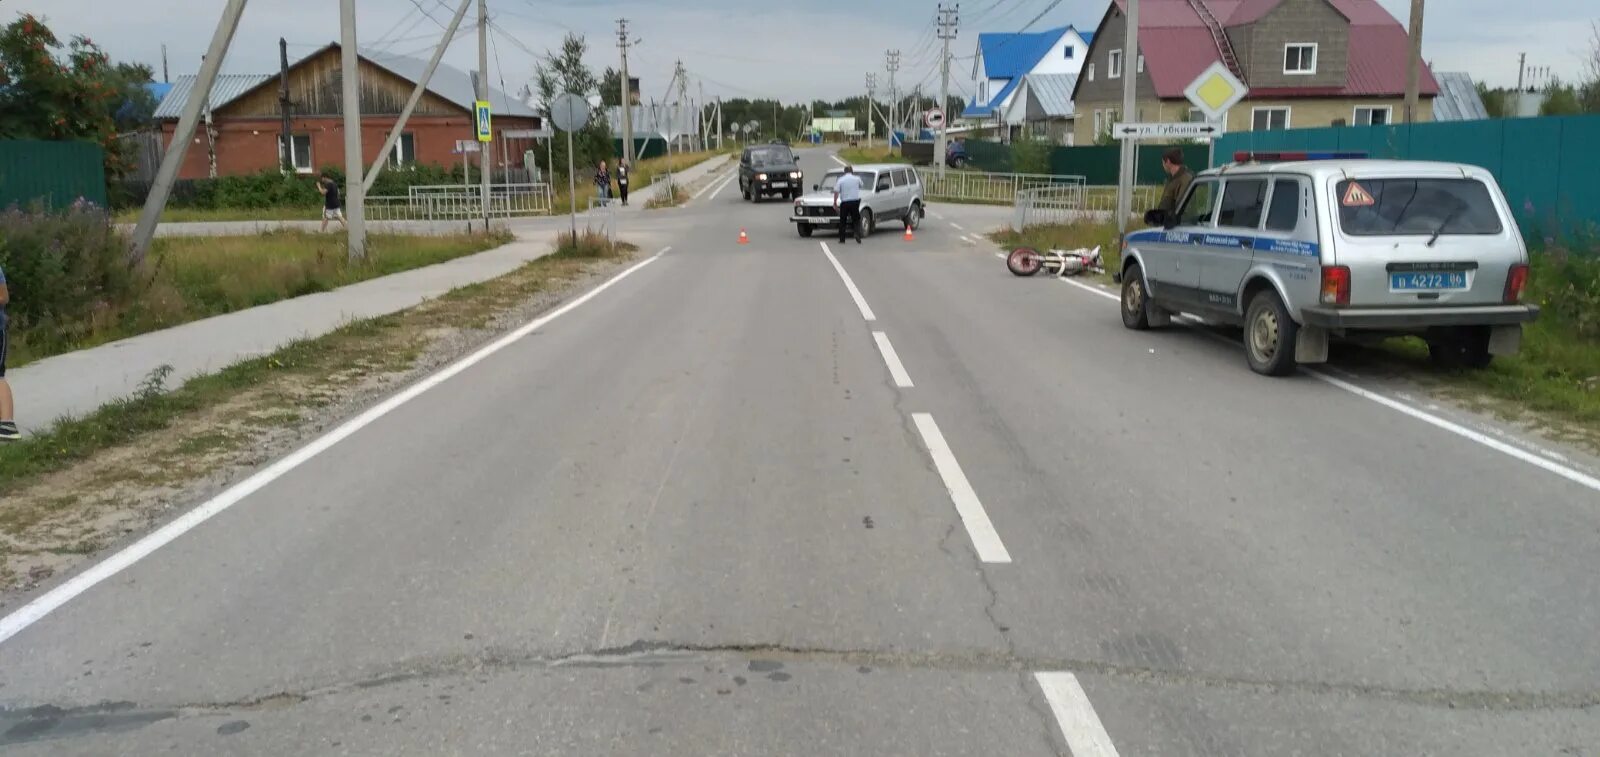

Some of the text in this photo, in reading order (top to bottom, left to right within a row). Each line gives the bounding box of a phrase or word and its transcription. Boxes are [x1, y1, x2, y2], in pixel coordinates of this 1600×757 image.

[1157, 125, 1198, 136] Губкина
[1165, 232, 1189, 243] ПОЛИЦИЯ
[1411, 274, 1442, 288] 4272
[1450, 273, 1462, 284] 06
